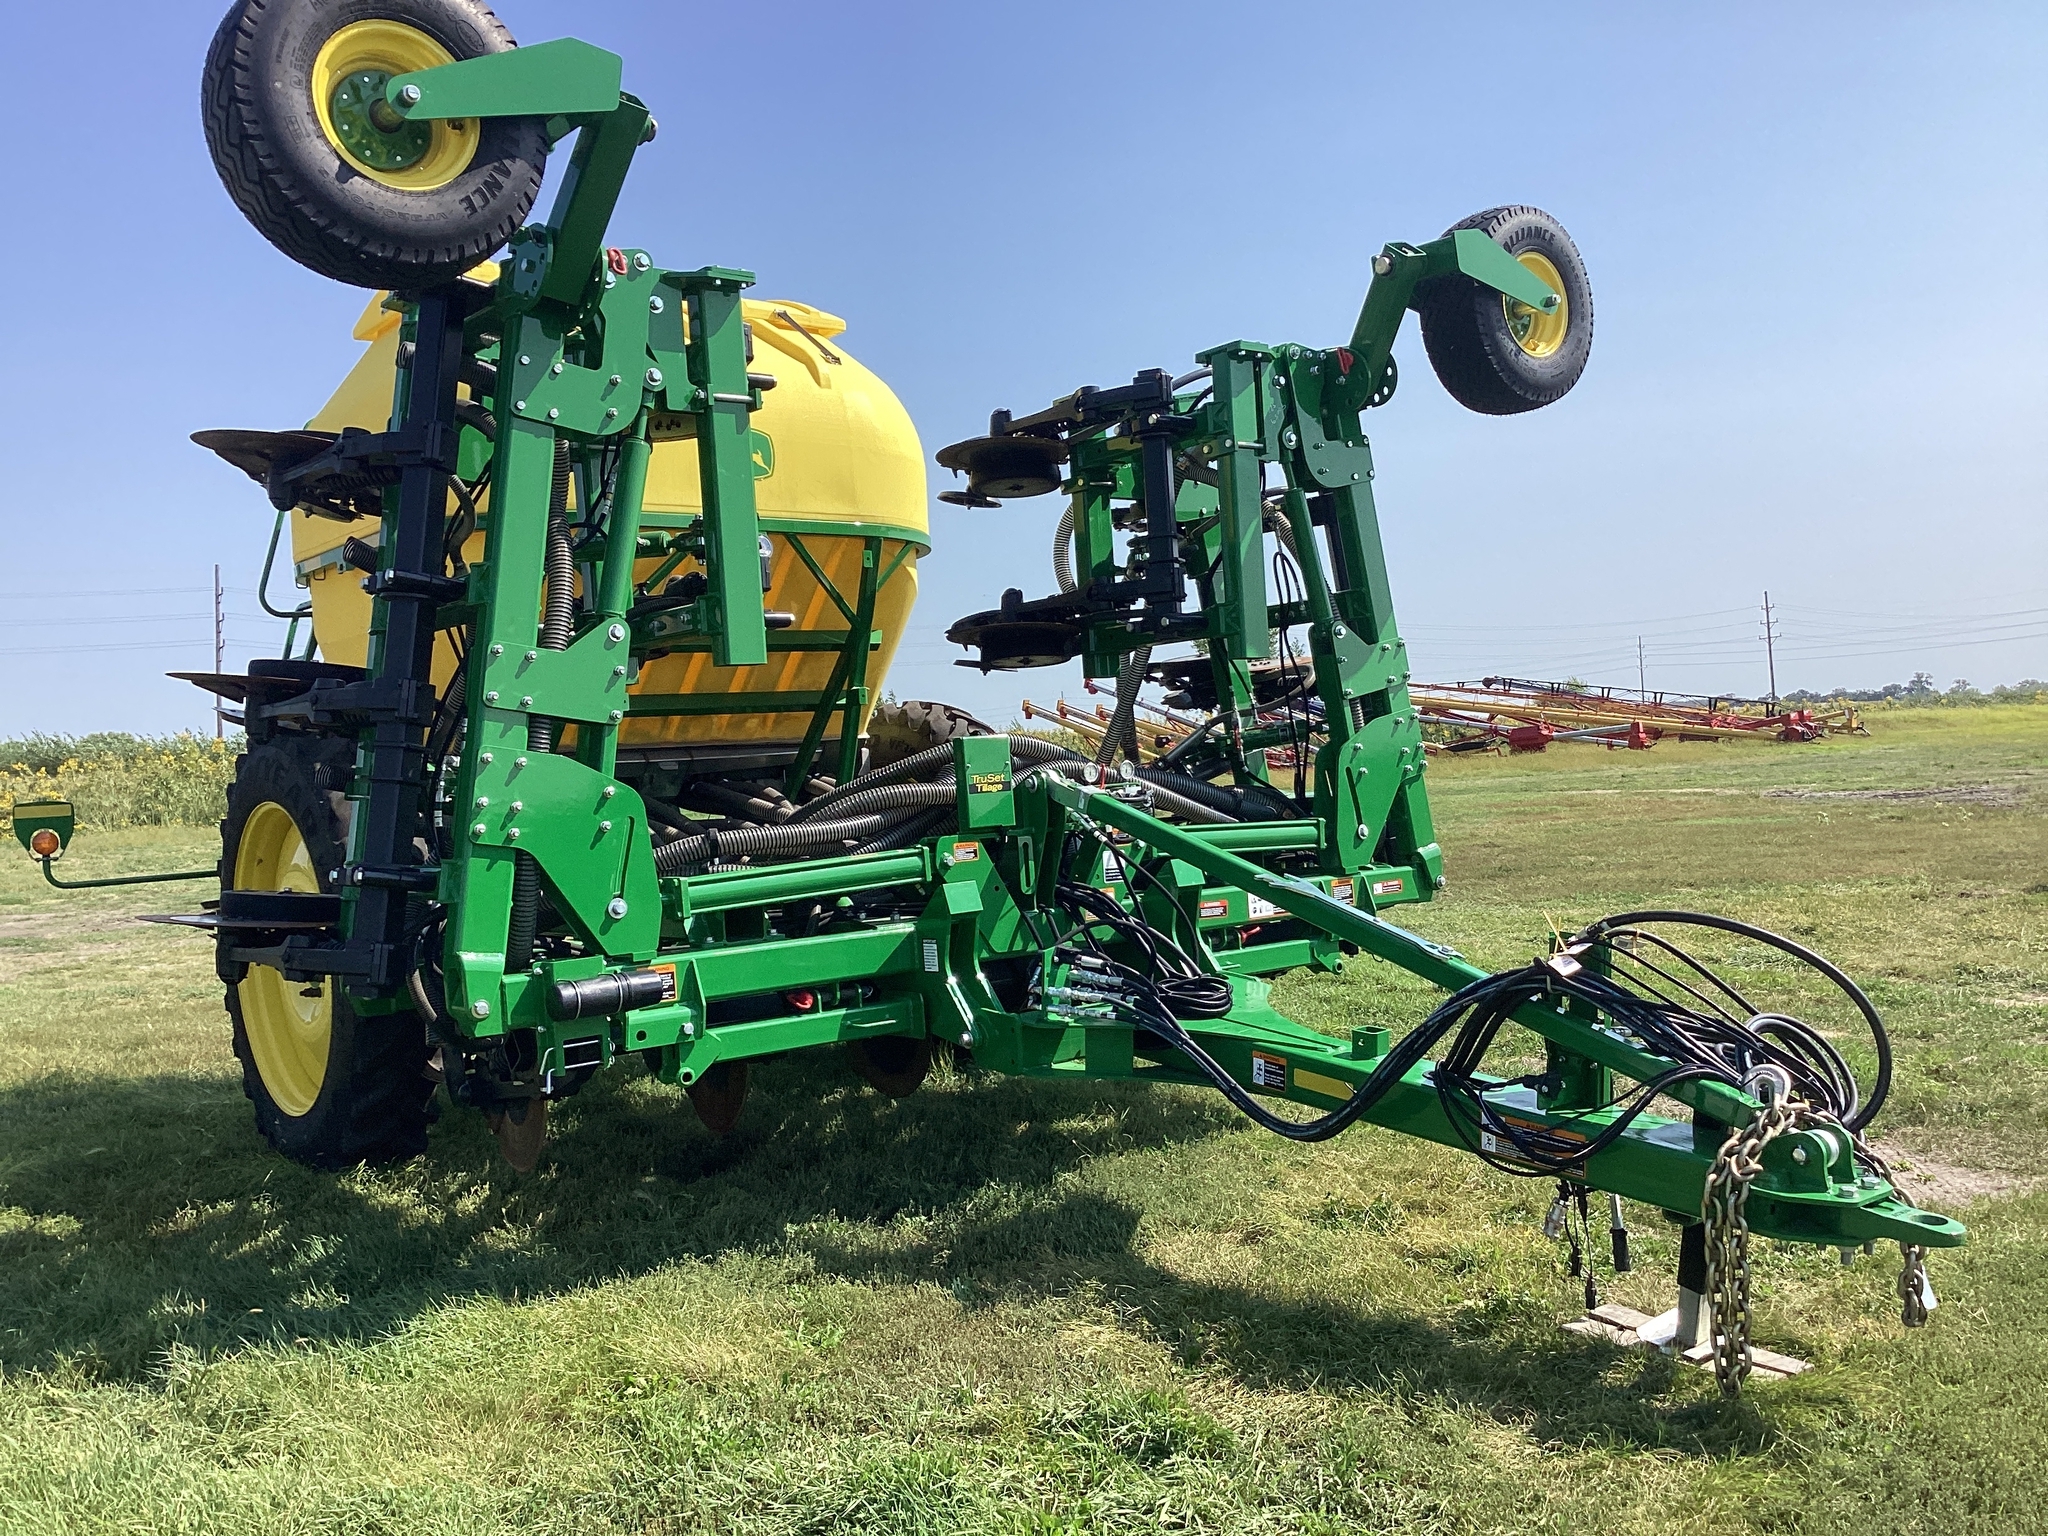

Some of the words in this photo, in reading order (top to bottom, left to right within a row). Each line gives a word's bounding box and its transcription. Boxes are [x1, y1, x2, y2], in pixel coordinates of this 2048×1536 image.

[1503, 225, 1556, 254] ALLIANCE
[971, 773, 1005, 784] TruSet
[975, 783, 1003, 793] Tillage
